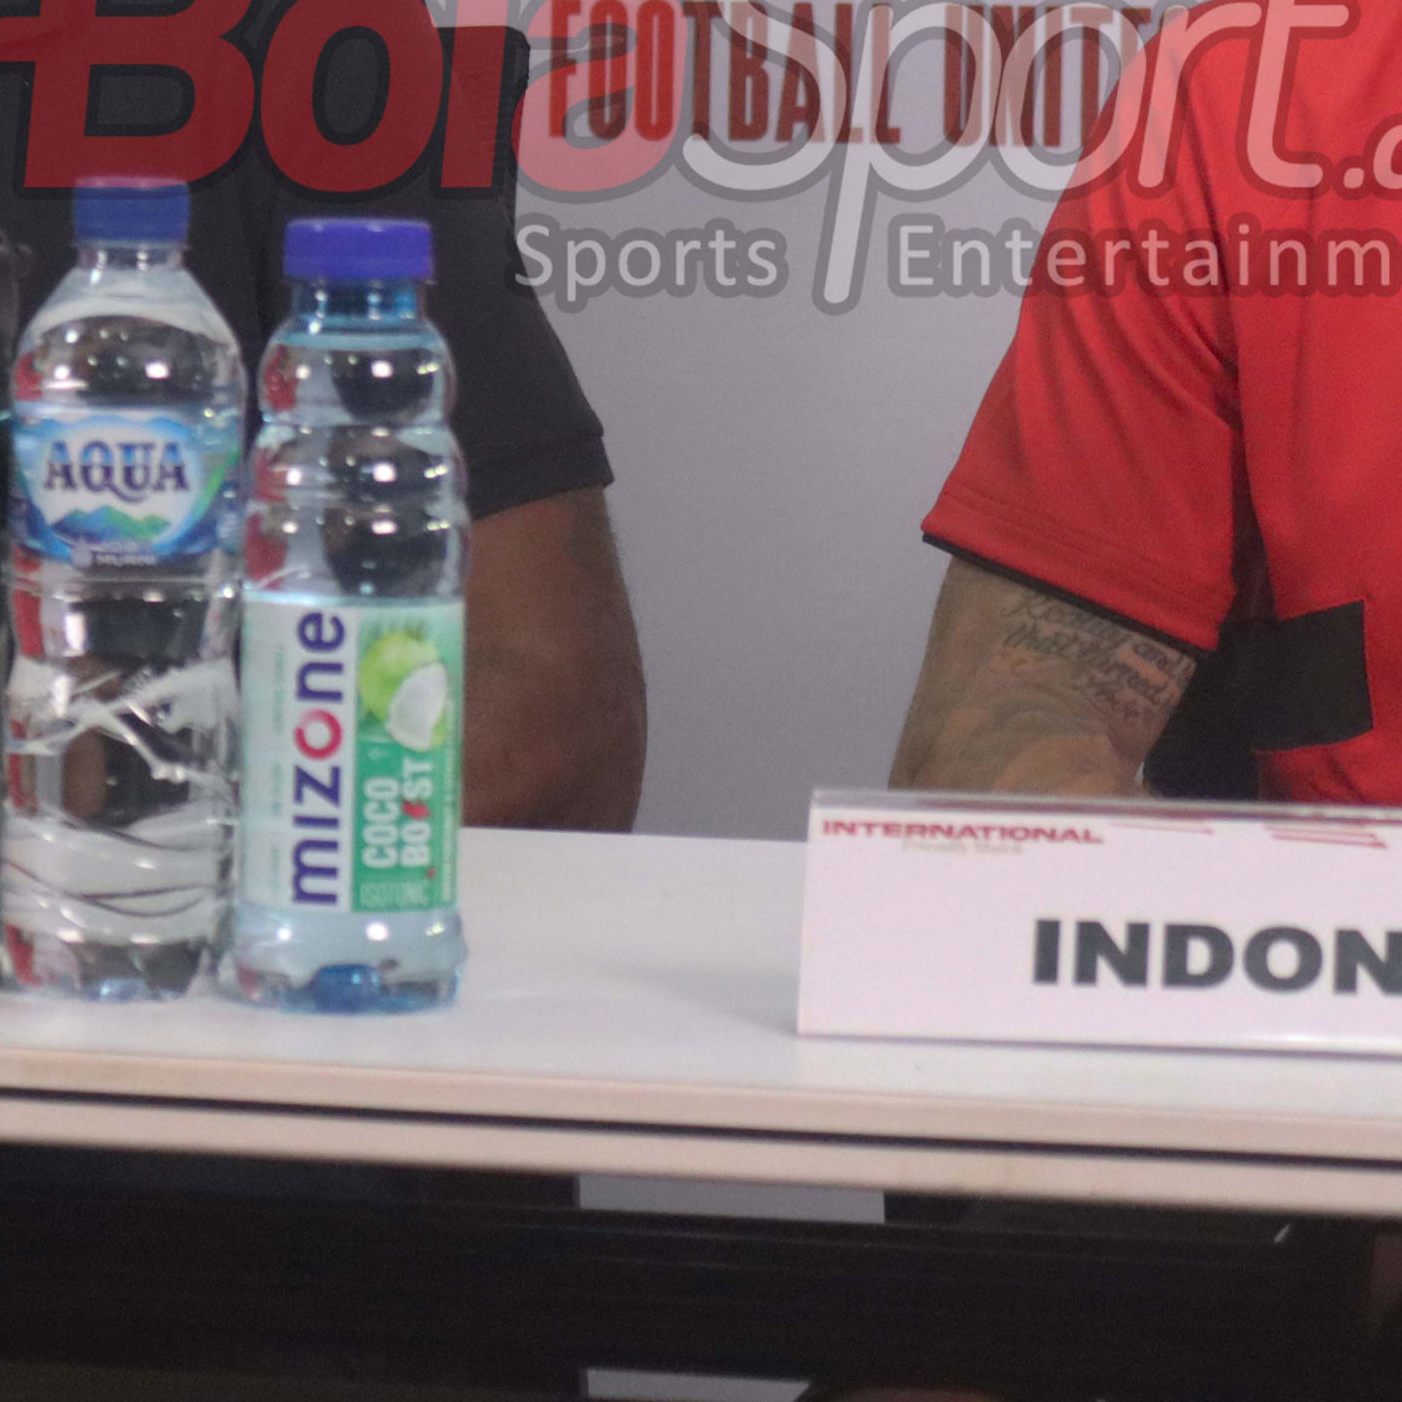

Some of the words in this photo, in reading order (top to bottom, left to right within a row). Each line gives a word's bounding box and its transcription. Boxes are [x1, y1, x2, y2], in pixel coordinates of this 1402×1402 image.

[44, 441, 189, 503] AQUA
[292, 610, 345, 905] mizone
[361, 778, 398, 868] COCO
[823, 821, 1103, 844] INTERNATIONAL
